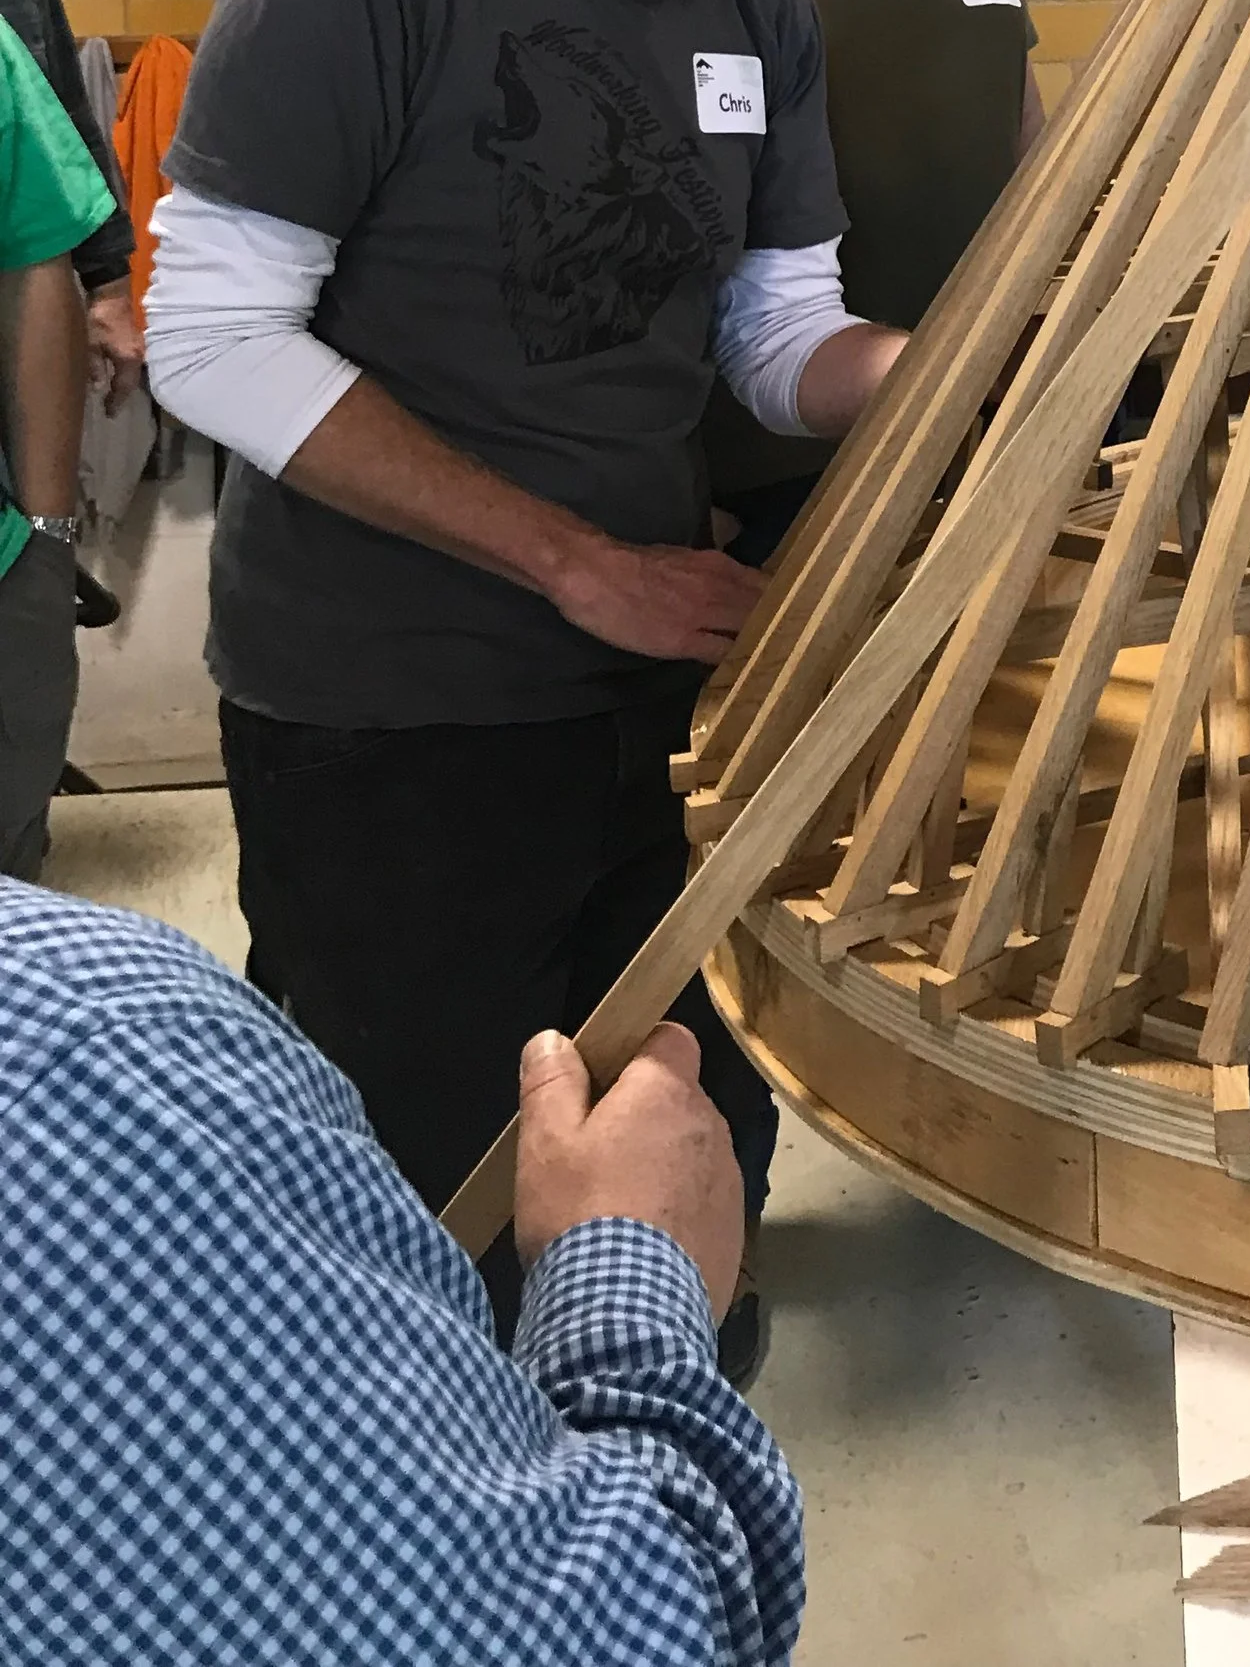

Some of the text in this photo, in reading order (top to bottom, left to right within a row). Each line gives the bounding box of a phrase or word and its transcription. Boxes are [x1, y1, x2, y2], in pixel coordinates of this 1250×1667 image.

[522, 19, 736, 247] Woodworking Festival
[719, 92, 752, 113] Chris
